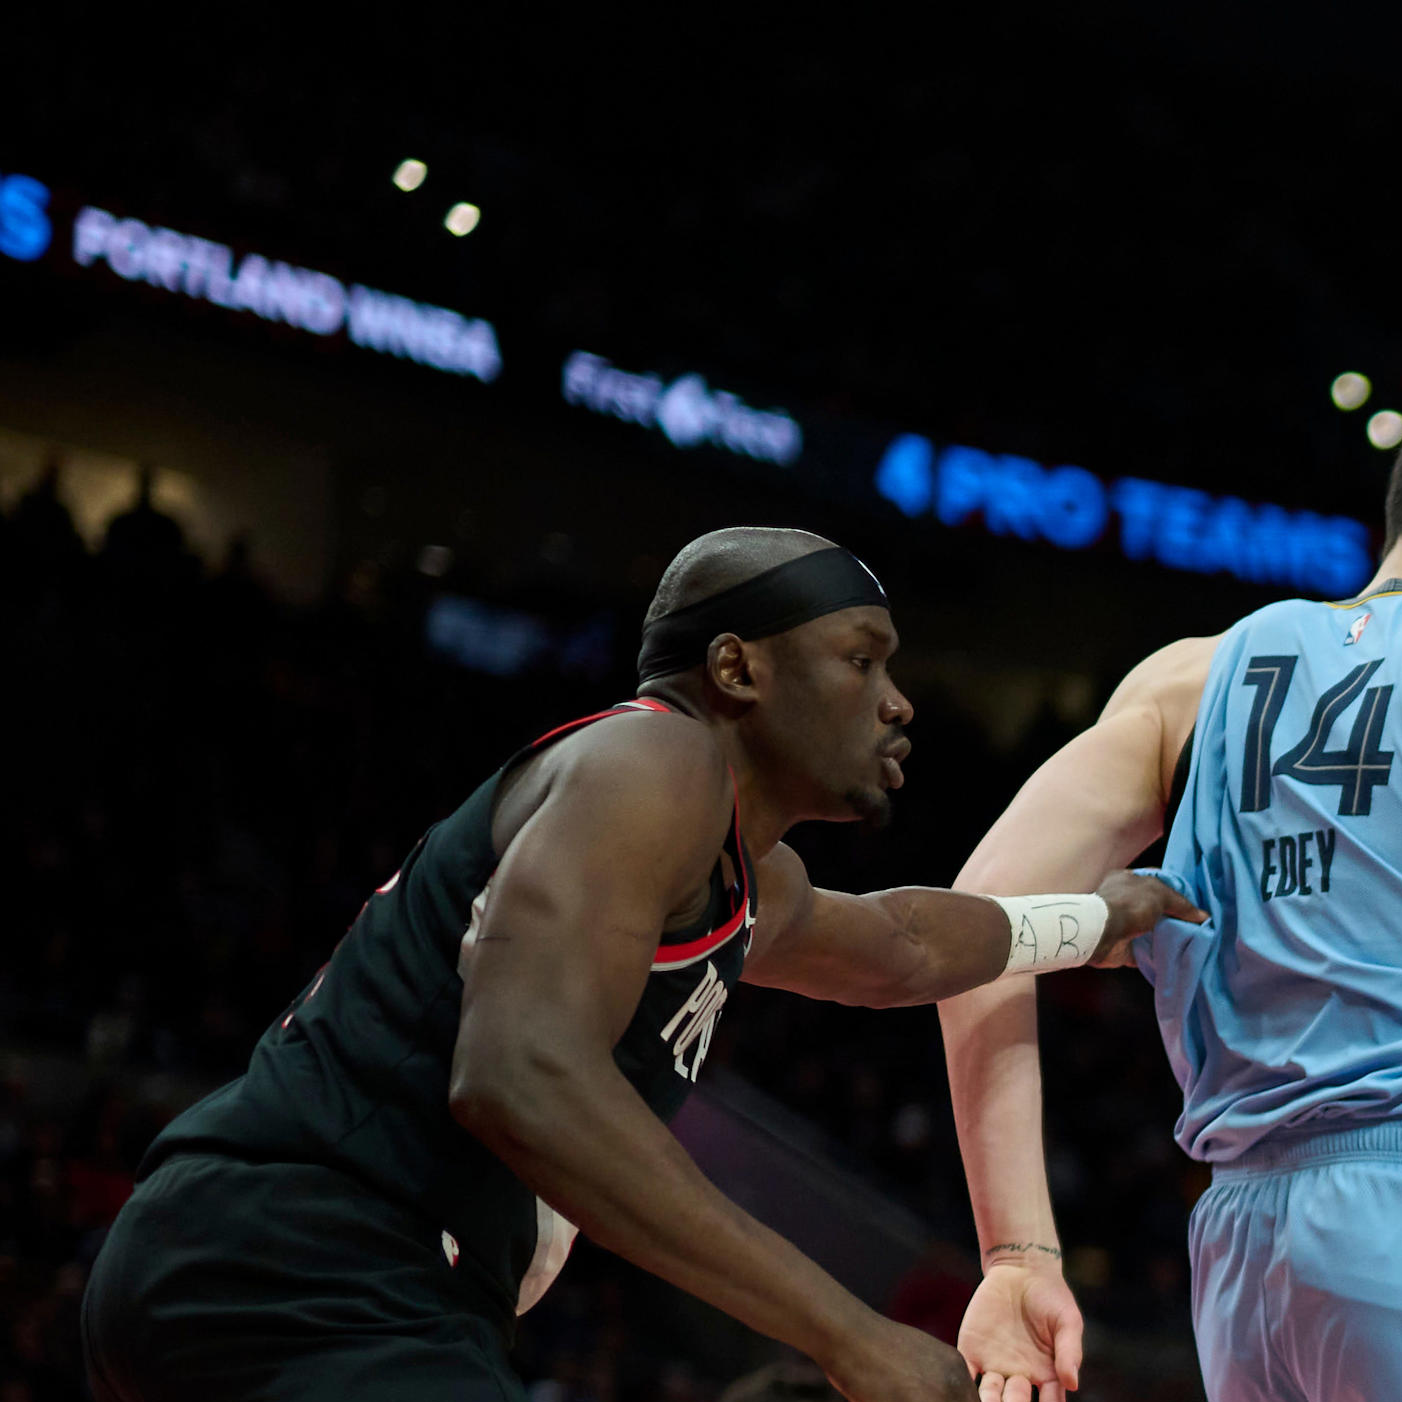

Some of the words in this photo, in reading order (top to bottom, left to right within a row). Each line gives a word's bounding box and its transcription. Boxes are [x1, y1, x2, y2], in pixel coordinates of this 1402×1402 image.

[74, 206, 347, 335] PORTLAND
[937, 444, 1105, 549] PRO
[1239, 655, 1394, 816] 14
[1260, 828, 1335, 902] EDEY
